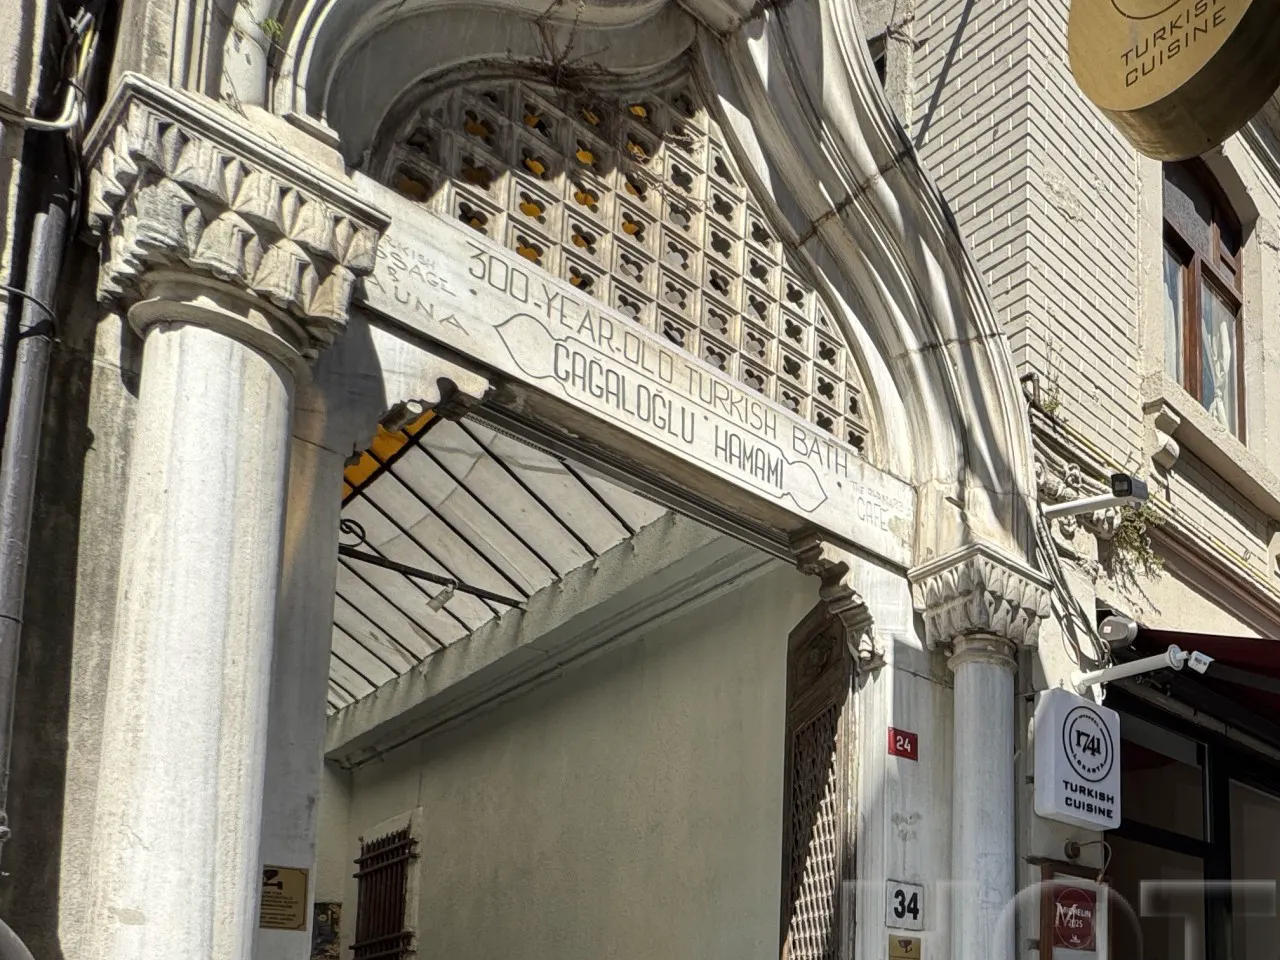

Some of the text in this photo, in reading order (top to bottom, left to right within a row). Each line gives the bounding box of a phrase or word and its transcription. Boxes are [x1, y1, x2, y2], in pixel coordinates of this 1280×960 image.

[1121, 0, 1217, 66] TURKIS
[1125, 6, 1227, 87] CUISINE
[376, 245, 457, 297] SSAGE
[385, 233, 435, 270] RKISH
[362, 274, 470, 336] AUNA
[466, 239, 848, 478] 300-YEAR-OLD TURKISH BATH
[714, 425, 784, 490] HAMAMI
[896, 735, 912, 753] 24
[1075, 729, 1102, 757] 1741
[1062, 780, 1115, 805] TURKISH
[1065, 797, 1114, 819] CUISINE
[893, 889, 920, 921] 34
